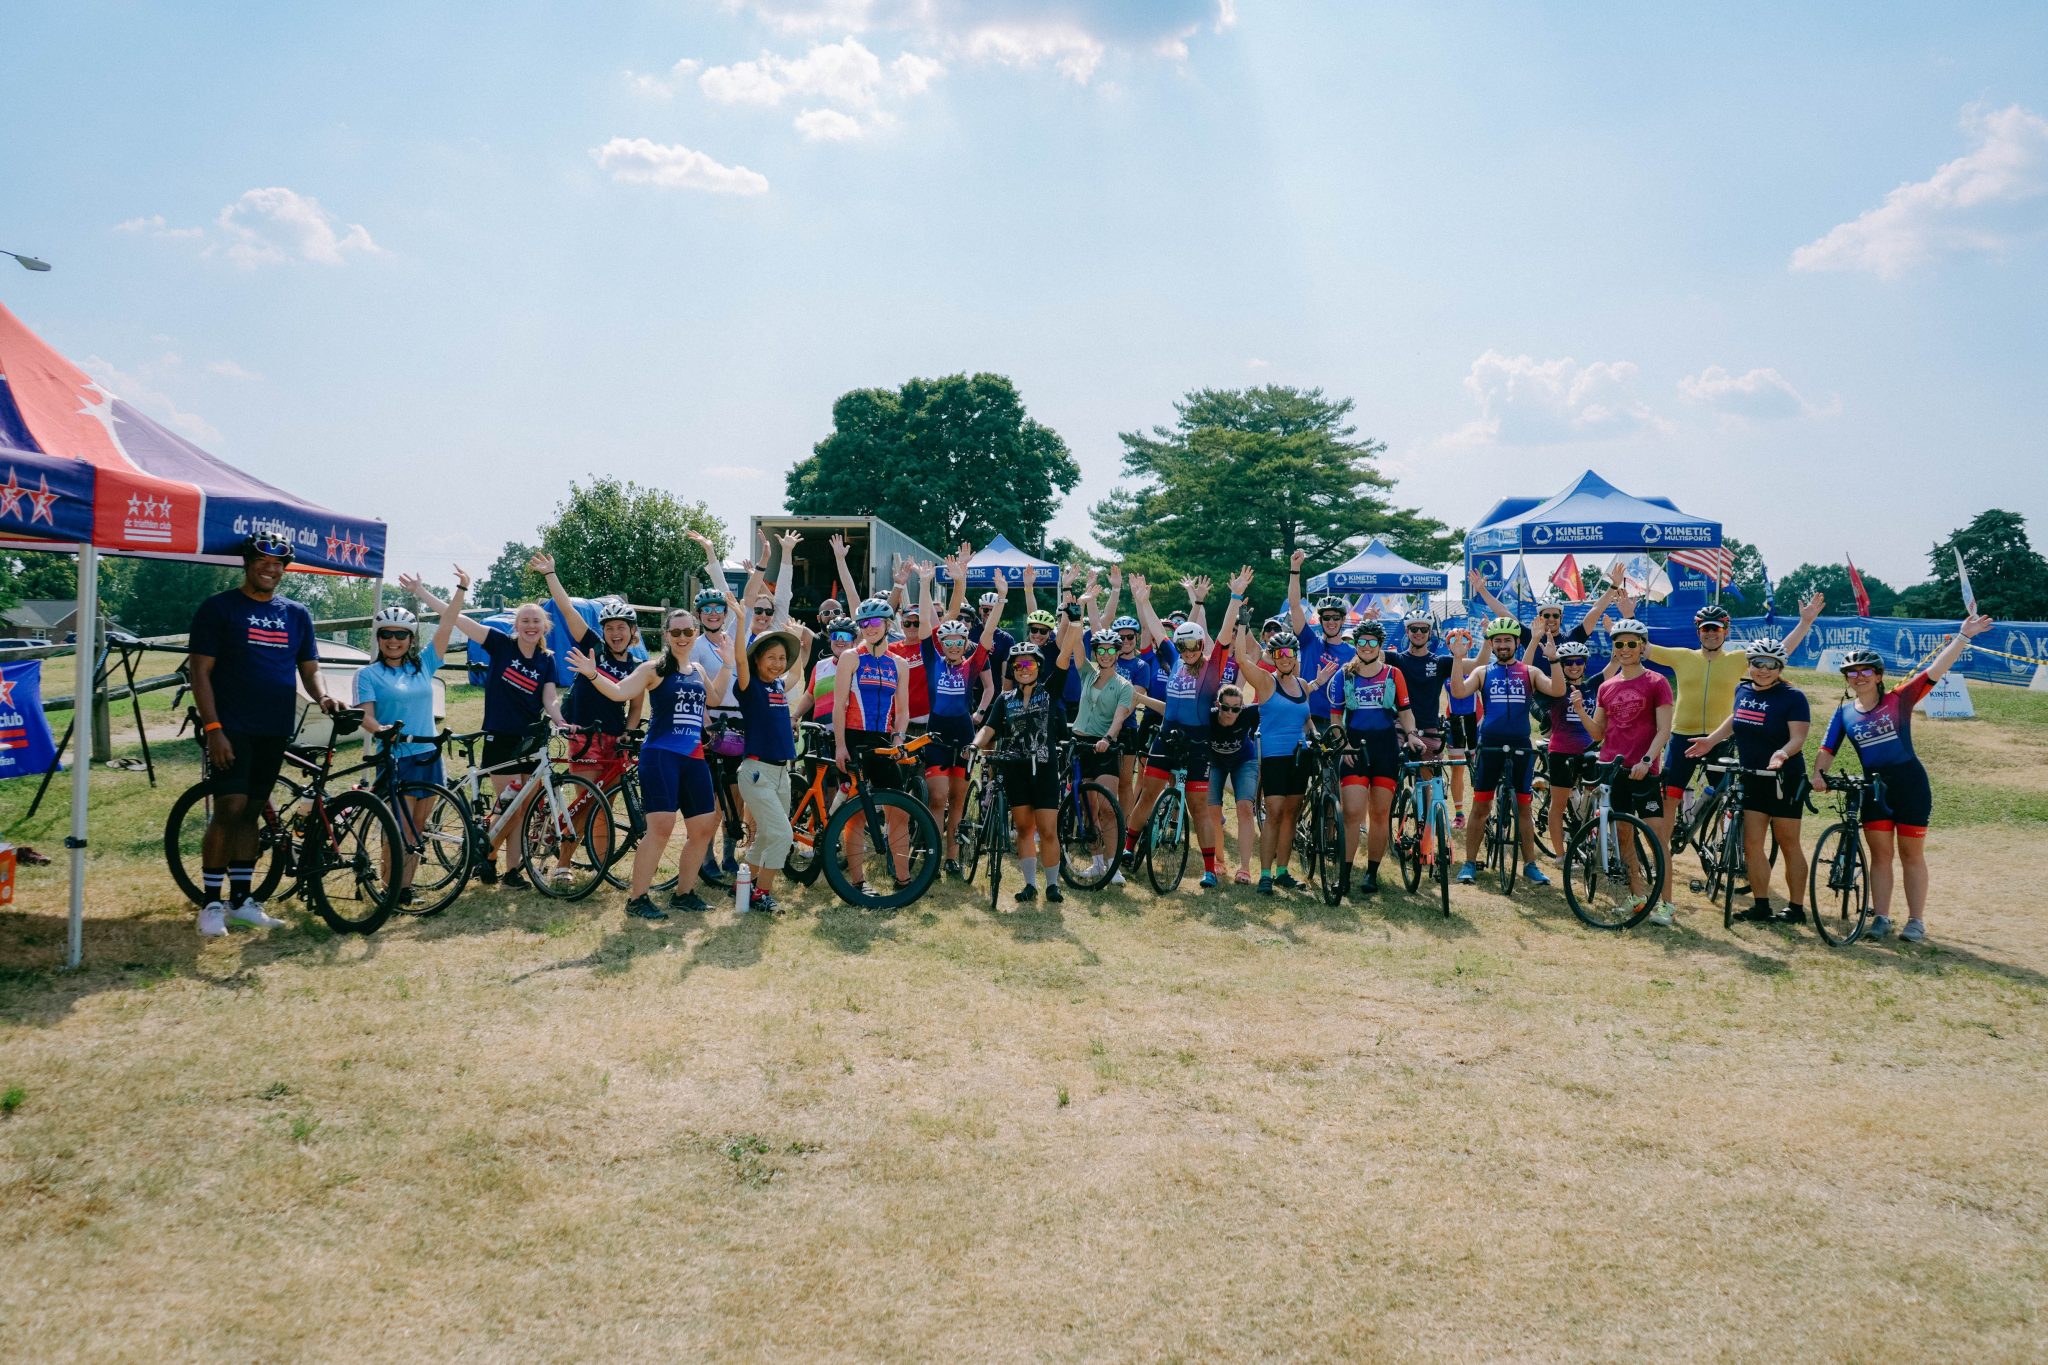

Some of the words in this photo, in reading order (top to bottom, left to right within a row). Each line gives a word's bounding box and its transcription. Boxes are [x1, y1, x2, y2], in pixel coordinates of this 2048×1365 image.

[233, 514, 249, 535] dc
[298, 527, 318, 547] club
[1556, 526, 1603, 536] KINETIC
[1664, 527, 1711, 536] KINETIC
[1747, 625, 1783, 641] KINETIC
[1826, 627, 1871, 645] KINETIC
[938, 678, 950, 687] dc
[953, 679, 965, 688] tri
[1168, 680, 1179, 690] dc
[1182, 678, 1196, 689] tri
[1490, 685, 1505, 694] dc
[1510, 685, 1525, 694] tri
[675, 700, 690, 713] dc
[693, 701, 704, 716] tri
[1855, 732, 1873, 741] dc
[1877, 720, 1894, 734] tri
